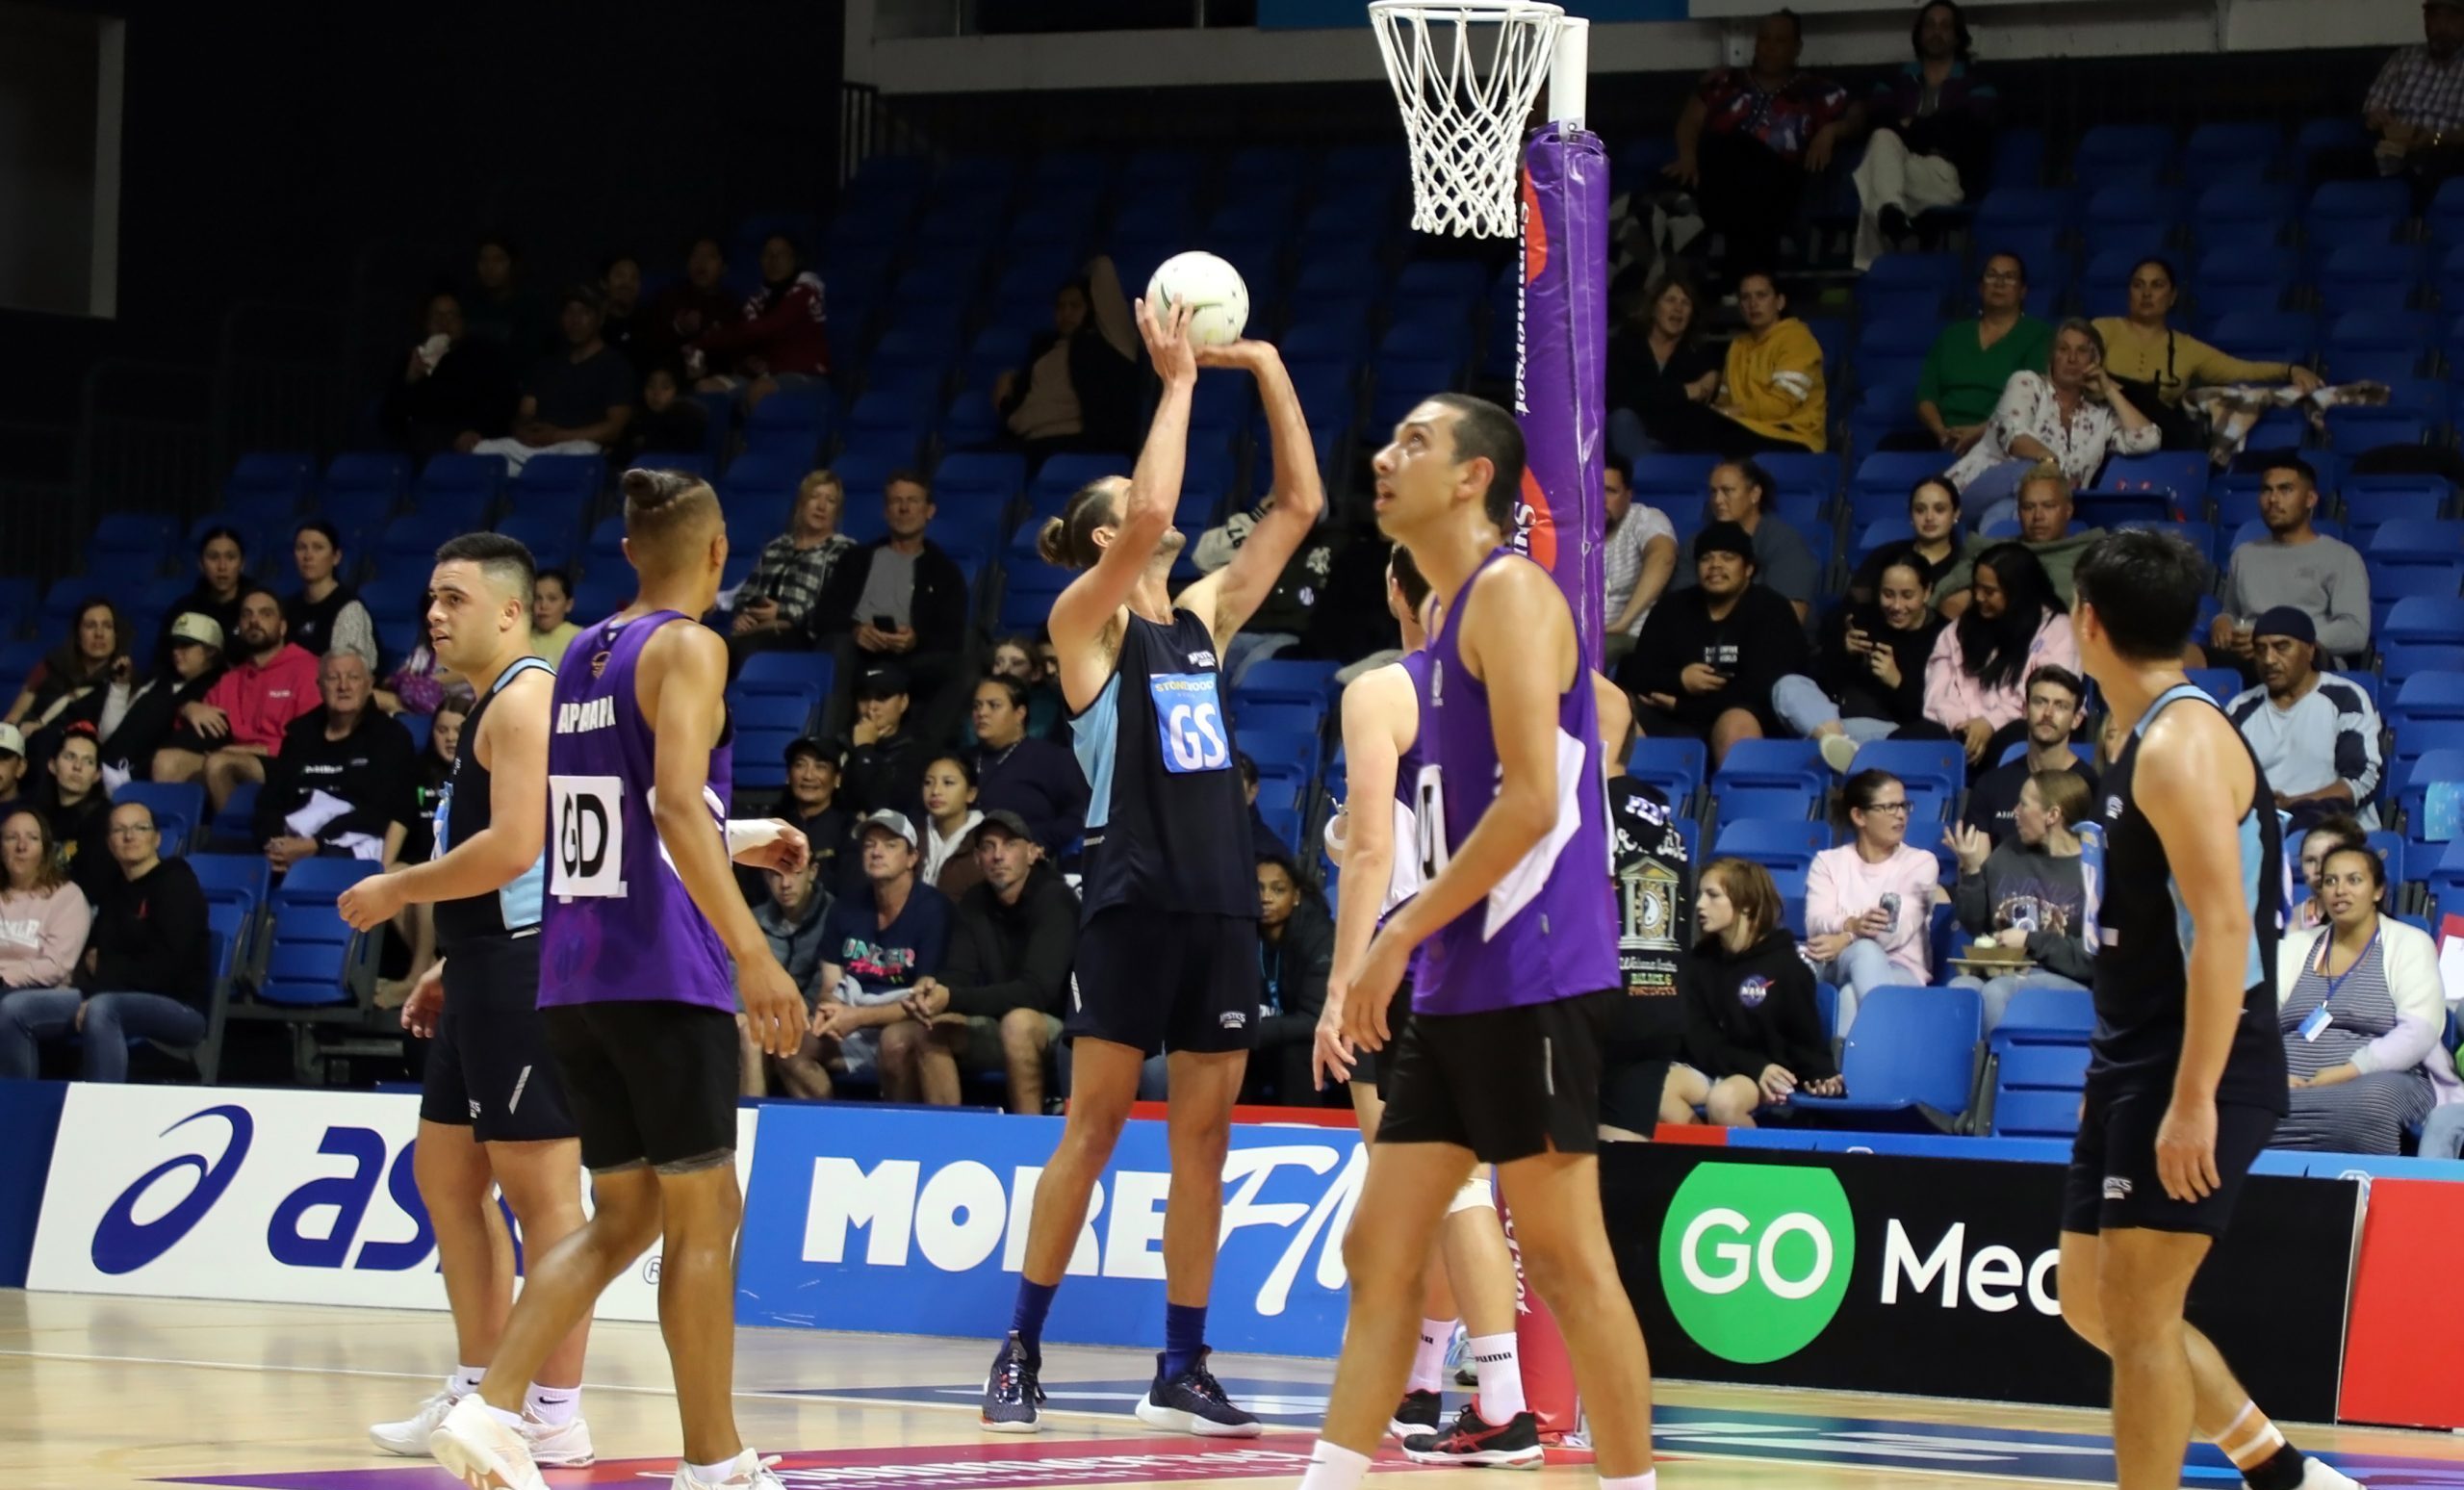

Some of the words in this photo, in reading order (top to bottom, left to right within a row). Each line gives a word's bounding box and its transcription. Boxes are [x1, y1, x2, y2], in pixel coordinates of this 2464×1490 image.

[1169, 702, 1226, 770] GS
[561, 792, 608, 878] GD
[802, 1156, 1172, 1280] MORE
[1681, 1208, 1834, 1299] GO
